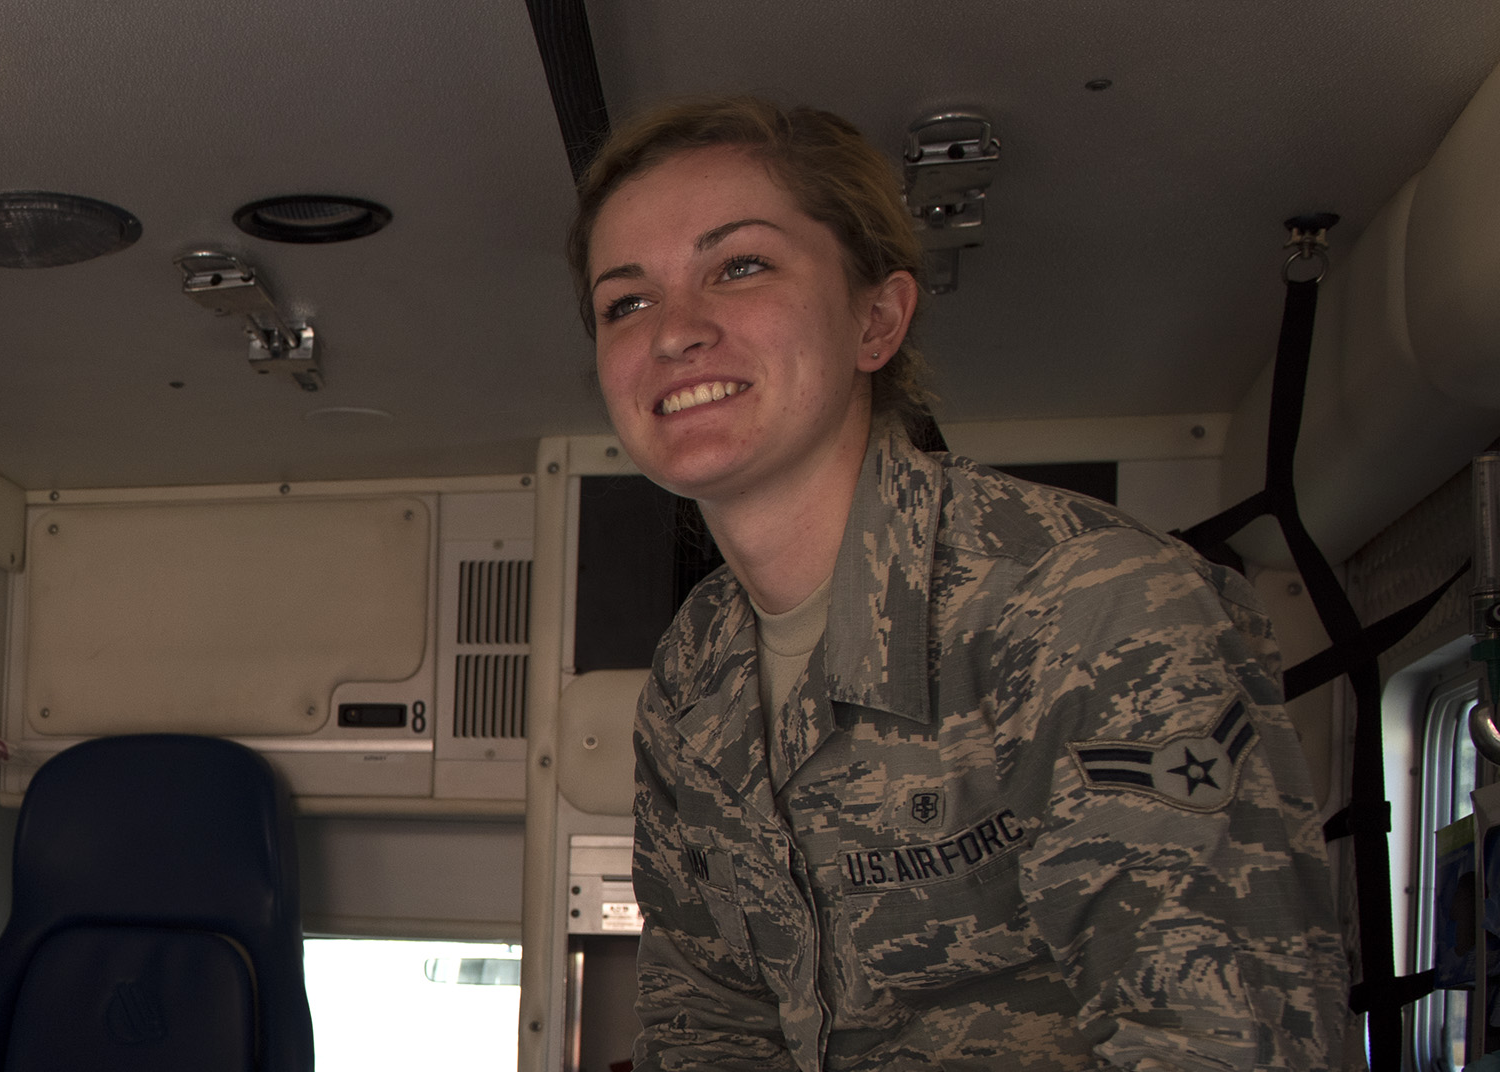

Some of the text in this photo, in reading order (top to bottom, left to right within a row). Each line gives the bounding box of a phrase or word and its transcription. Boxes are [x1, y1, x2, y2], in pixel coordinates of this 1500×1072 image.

[412, 700, 426, 733] 8
[846, 808, 1025, 886] U.S. AIR FORC
